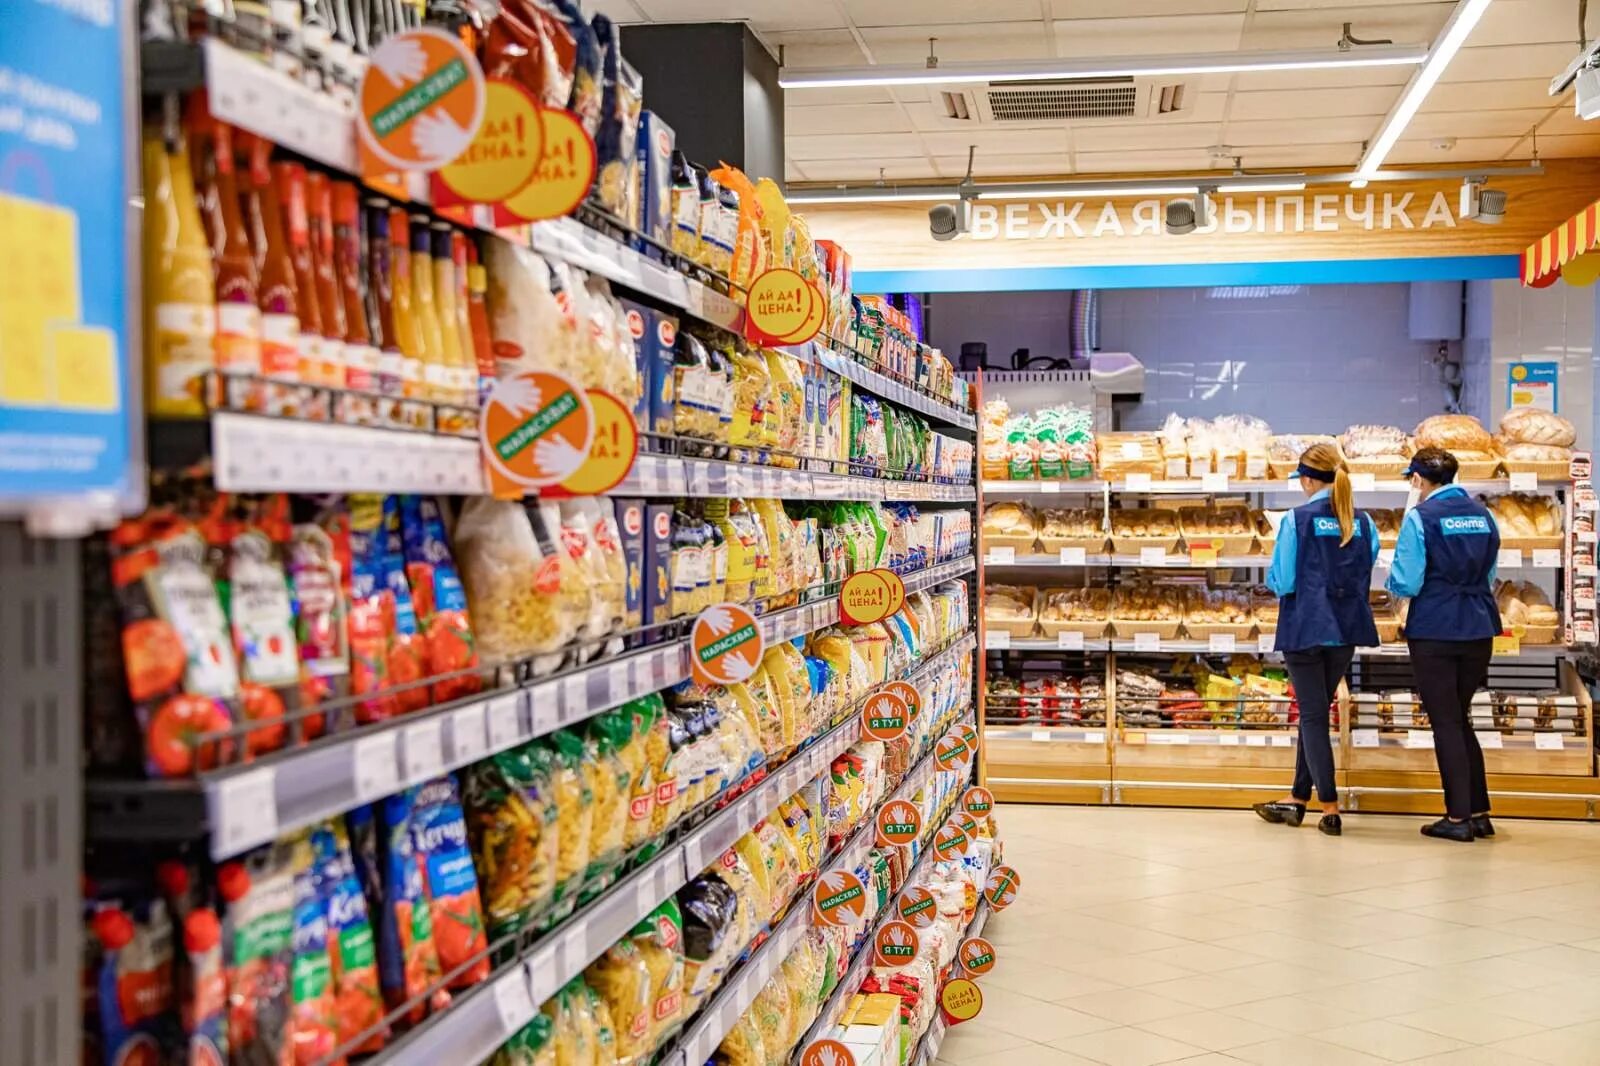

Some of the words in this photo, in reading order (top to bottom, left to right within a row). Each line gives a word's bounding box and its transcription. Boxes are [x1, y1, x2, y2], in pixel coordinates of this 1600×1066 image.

[972, 199, 1161, 239] ВЕЖАЯ
[758, 288, 773, 301] АЙ
[777, 290, 794, 301] ДА
[1445, 518, 1485, 529] Санта
[849, 587, 861, 596] АЙ
[864, 588, 877, 597] ДА
[702, 627, 754, 660] НАРАСХВАТ
[872, 719, 879, 728] Я
[882, 718, 901, 728] ТУТ
[887, 825, 894, 833] Я
[896, 824, 914, 833] ТУТ
[821, 886, 860, 909] НАРАСХВАТ
[894, 947, 912, 955] ТУТ
[977, 955, 991, 965] ТУТ
